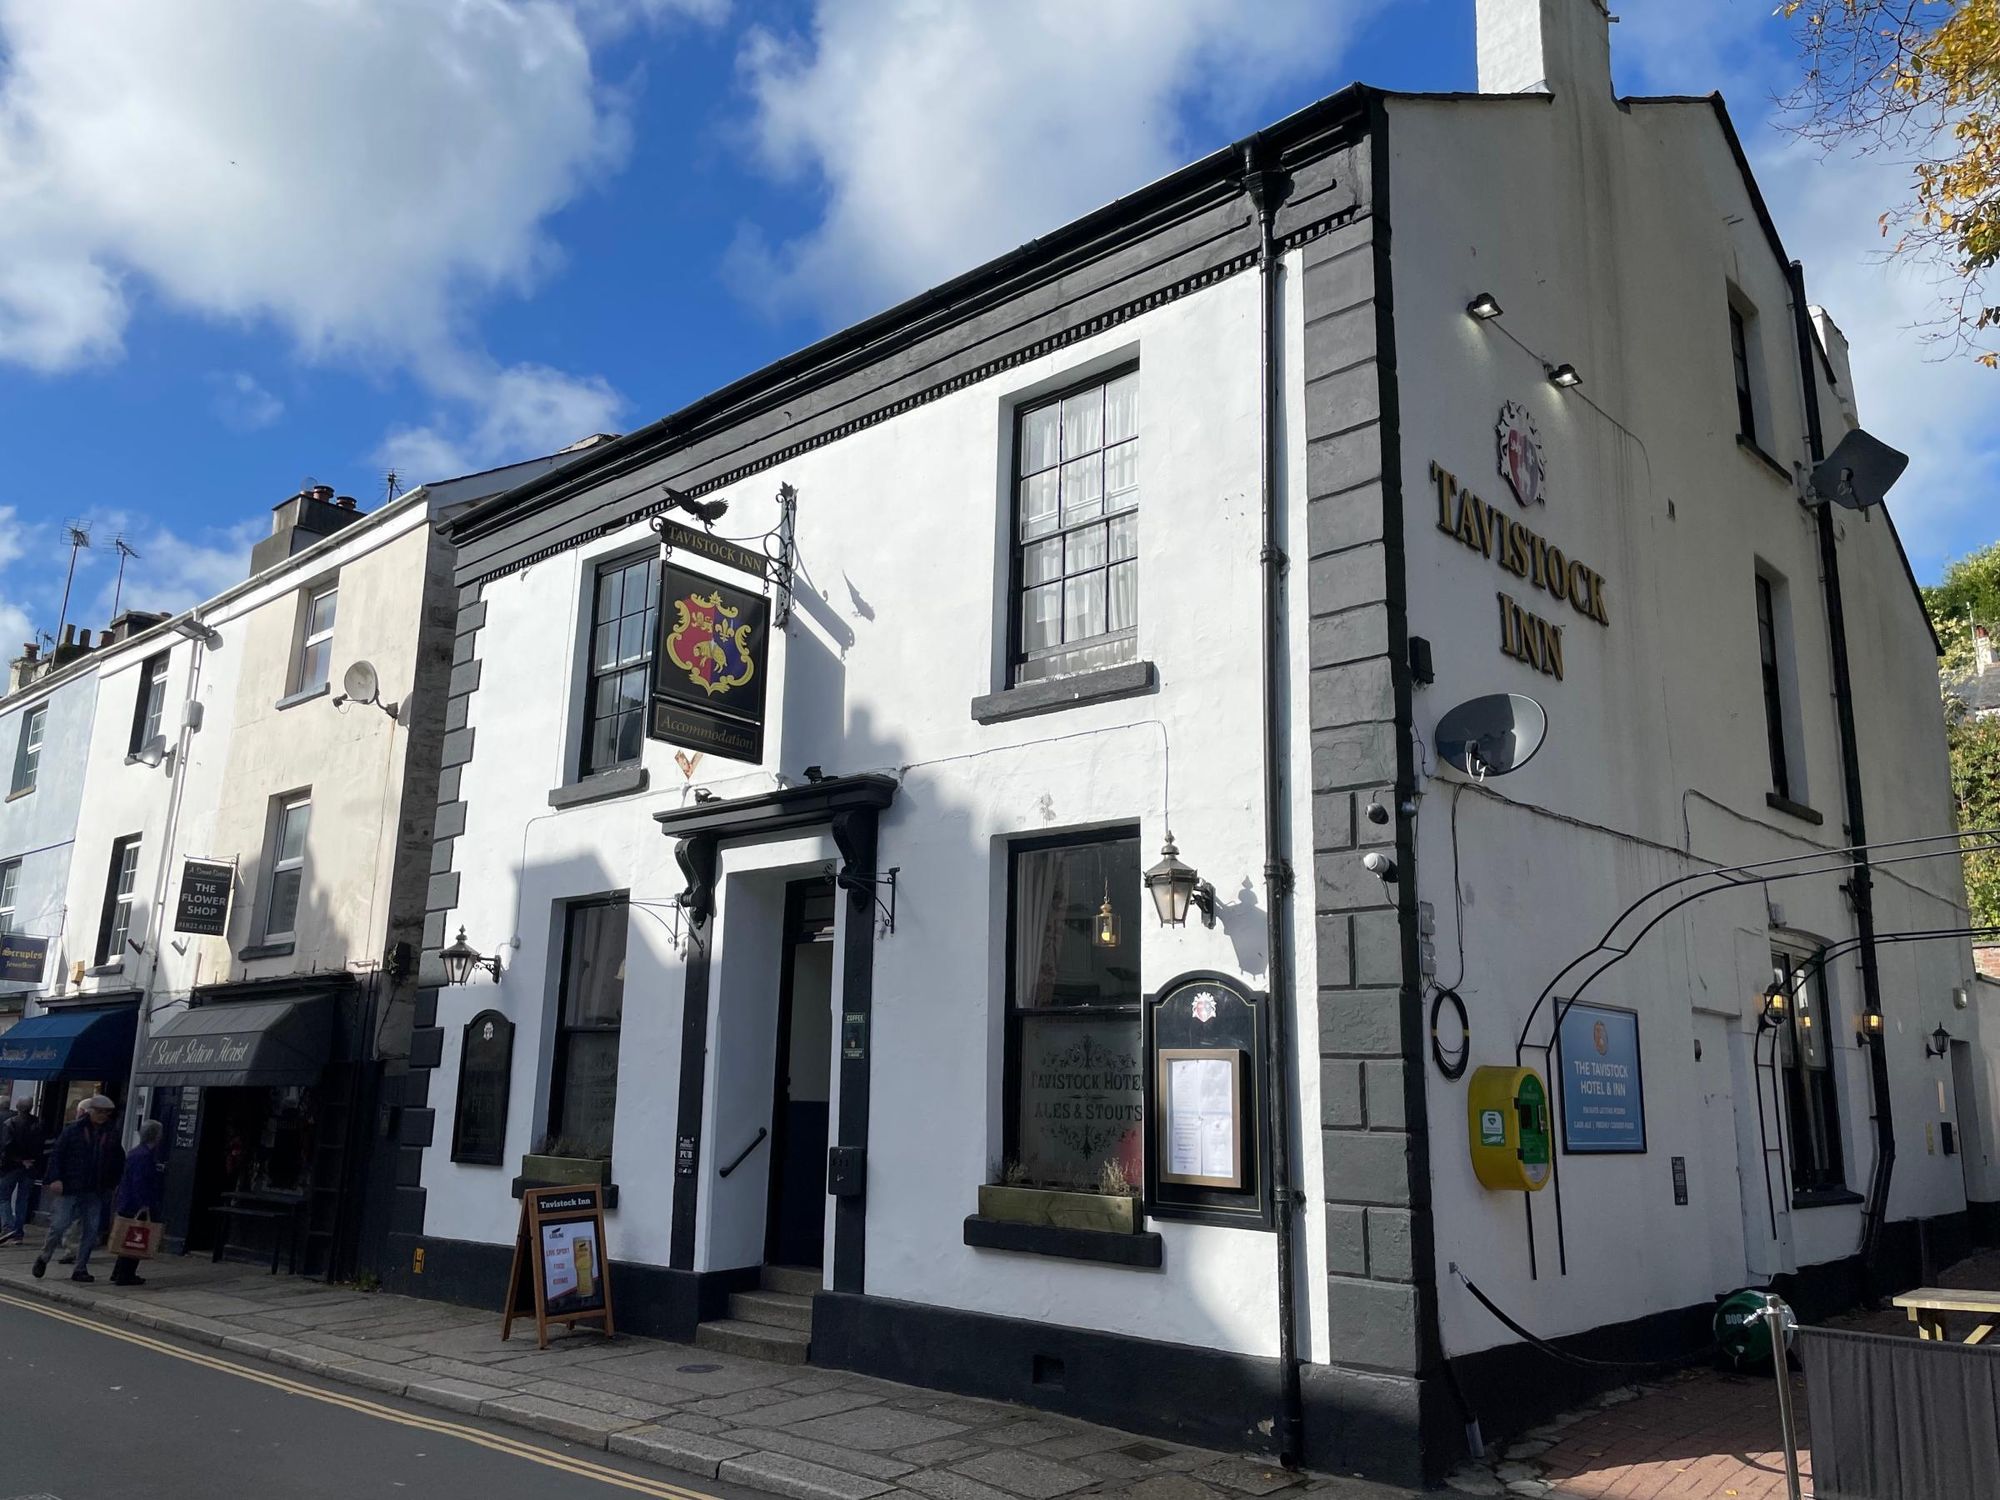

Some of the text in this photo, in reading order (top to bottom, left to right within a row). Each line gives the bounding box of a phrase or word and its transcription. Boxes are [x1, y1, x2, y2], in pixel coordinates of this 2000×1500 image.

[669, 525, 761, 571] TAVISTOCK INN
[1430, 459, 1609, 627] TAVISTOCK
[1497, 591, 1564, 681] INN
[661, 715, 753, 750] Accommodation
[195, 882, 217, 893] THE
[181, 893, 226, 906] FLOWER
[187, 905, 217, 916] SHOP
[846, 1014, 864, 1022] COFFEE
[1574, 1060, 1629, 1078] THE TAVISTOCK
[1032, 1071, 1142, 1091] TAVISTOCK HOTE
[1580, 1080, 1626, 1097] HOTEL & INN
[1034, 1102, 1142, 1121] ALES & STOUTS
[680, 1150, 693, 1158] PUB
[540, 1198, 591, 1209] Tavistock Inn
